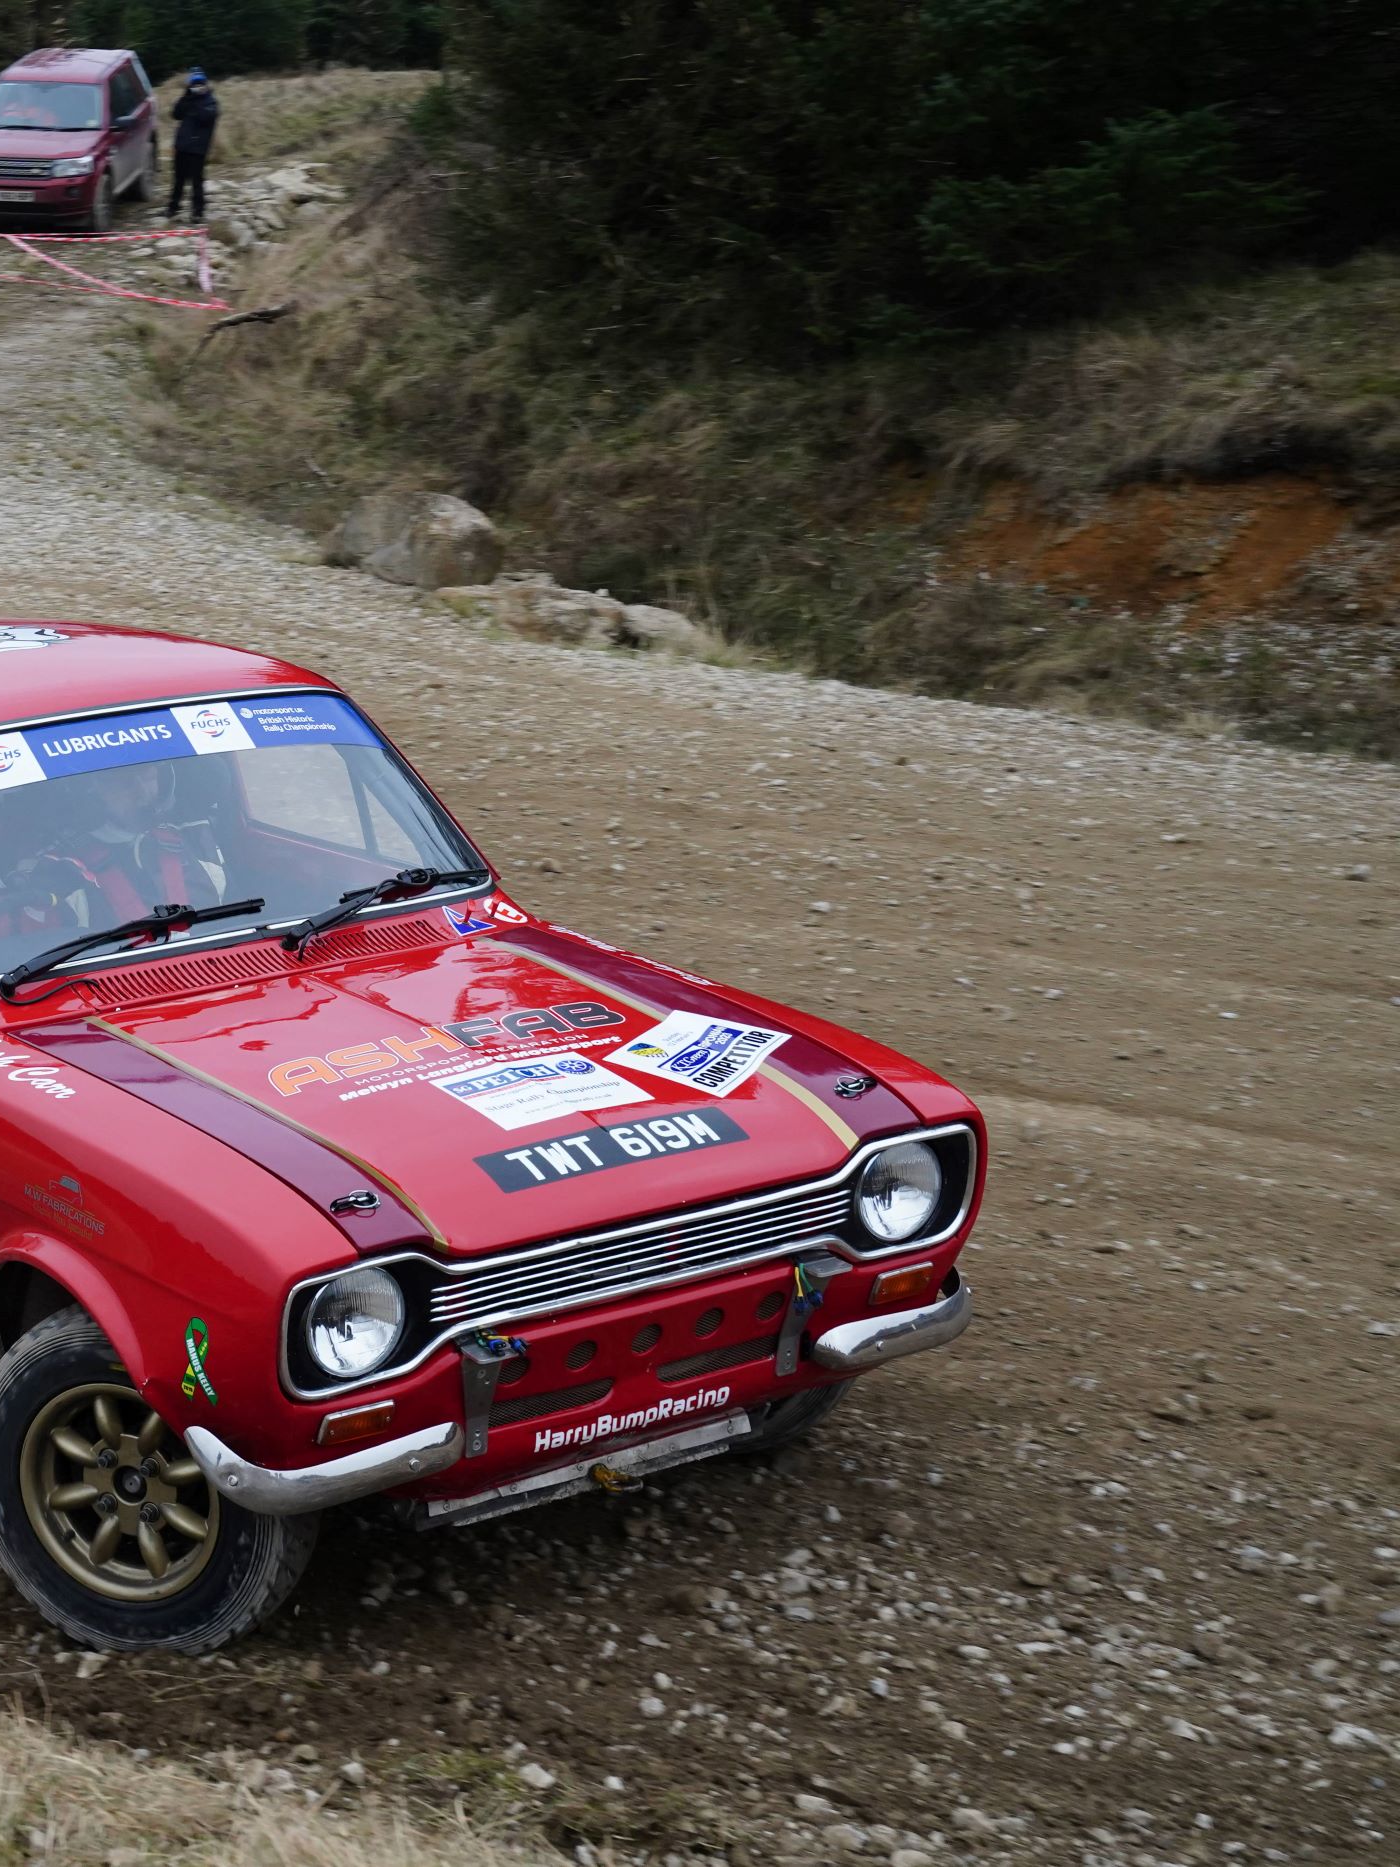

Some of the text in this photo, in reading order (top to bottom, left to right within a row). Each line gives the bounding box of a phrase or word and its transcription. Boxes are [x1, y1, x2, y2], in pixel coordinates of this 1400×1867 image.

[191, 717, 231, 729] FUCHS
[253, 707, 293, 715] motorsport
[258, 715, 315, 725] British Historic
[263, 723, 337, 733] Rally Championship
[42, 724, 172, 757] LUBRICANTS
[268, 1001, 626, 1097] ASHFAB
[338, 1076, 414, 1101] Melvyn
[415, 1052, 510, 1081] Langford
[512, 1034, 623, 1059] Motorsport
[354, 1033, 589, 1086] MOTORSPORT PREPARATION
[692, 1030, 776, 1088] COMPETITOR
[7, 1066, 77, 1100] Carr
[451, 1083, 473, 1095] SG
[472, 1065, 557, 1092] PETCH
[504, 1112, 722, 1183] TWT 619M
[42, 1195, 105, 1236] FABRICATIONS
[186, 1337, 202, 1372] MANUS
[197, 1372, 216, 1396] KELLY
[534, 1386, 731, 1453] HarryBumpRacing
